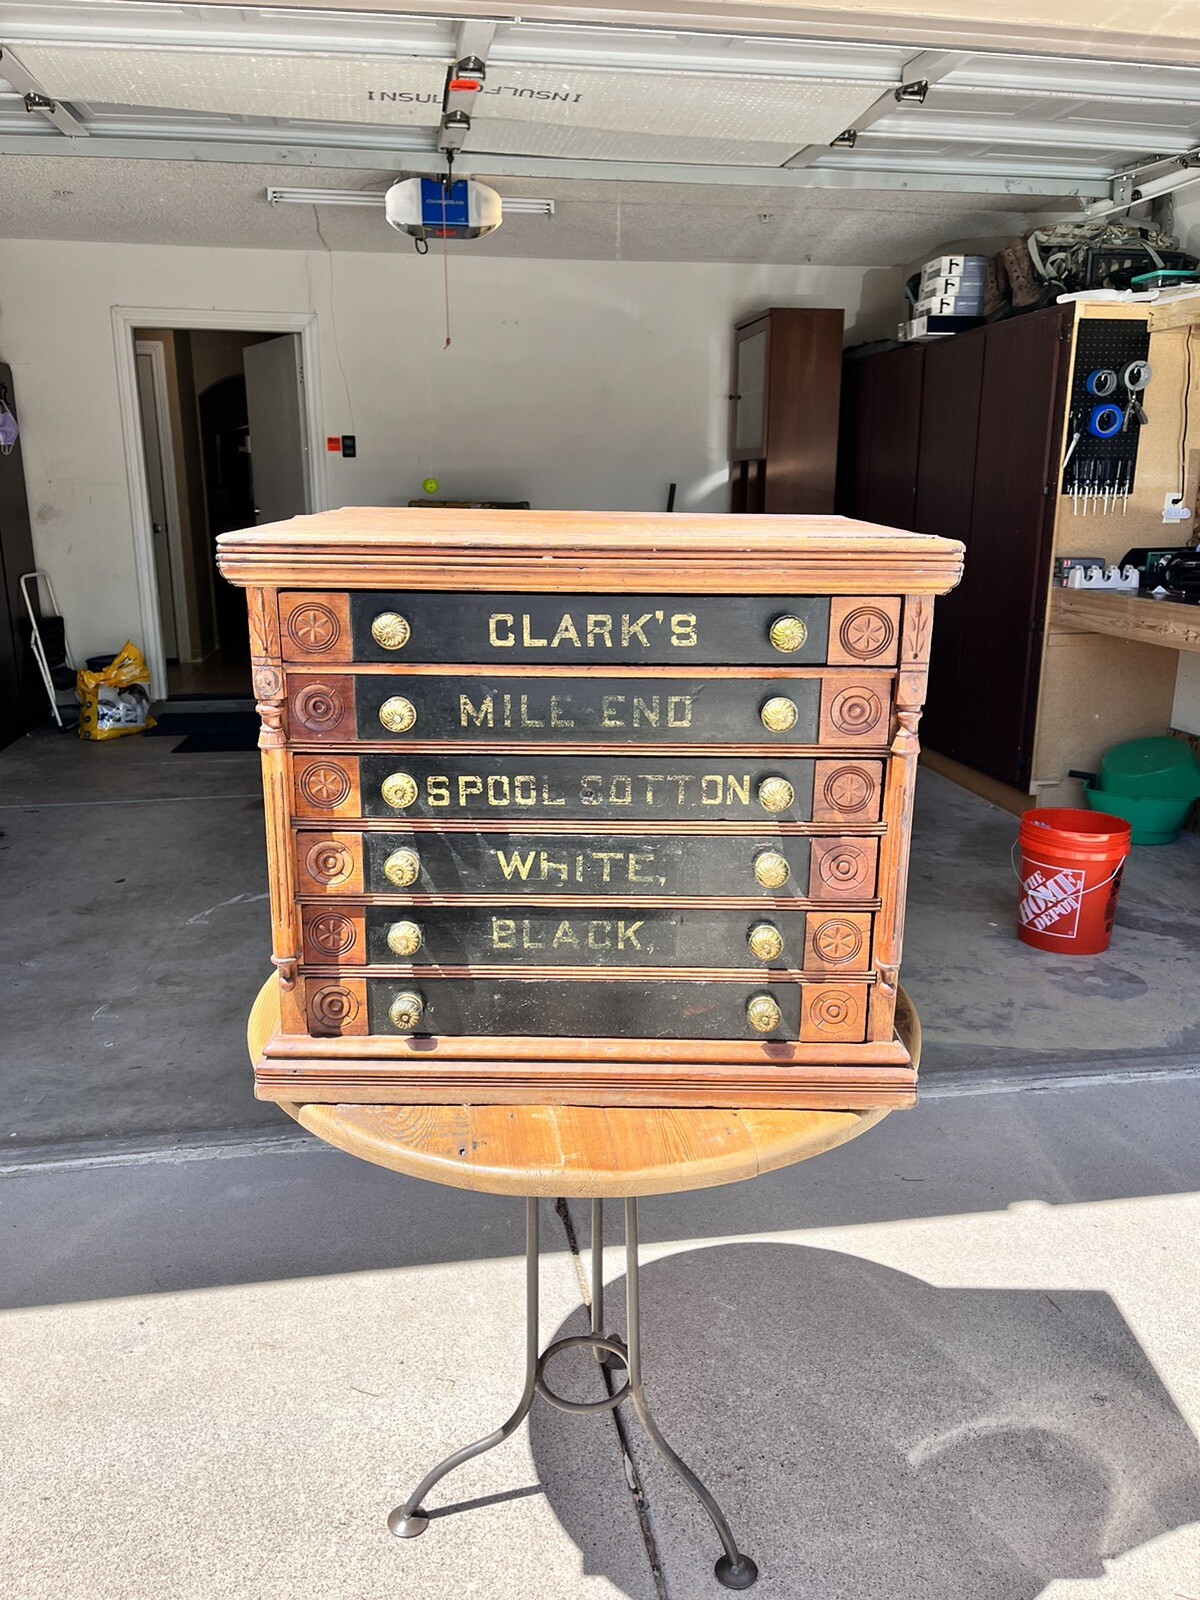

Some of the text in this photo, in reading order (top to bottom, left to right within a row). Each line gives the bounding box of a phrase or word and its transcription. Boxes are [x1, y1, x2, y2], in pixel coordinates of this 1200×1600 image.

[488, 610, 698, 648] CLARK'S
[426, 775, 566, 807] SPOOL
[1020, 870, 1082, 924] HOME
[1025, 871, 1046, 891] THE
[1033, 895, 1078, 931] DEPOT
